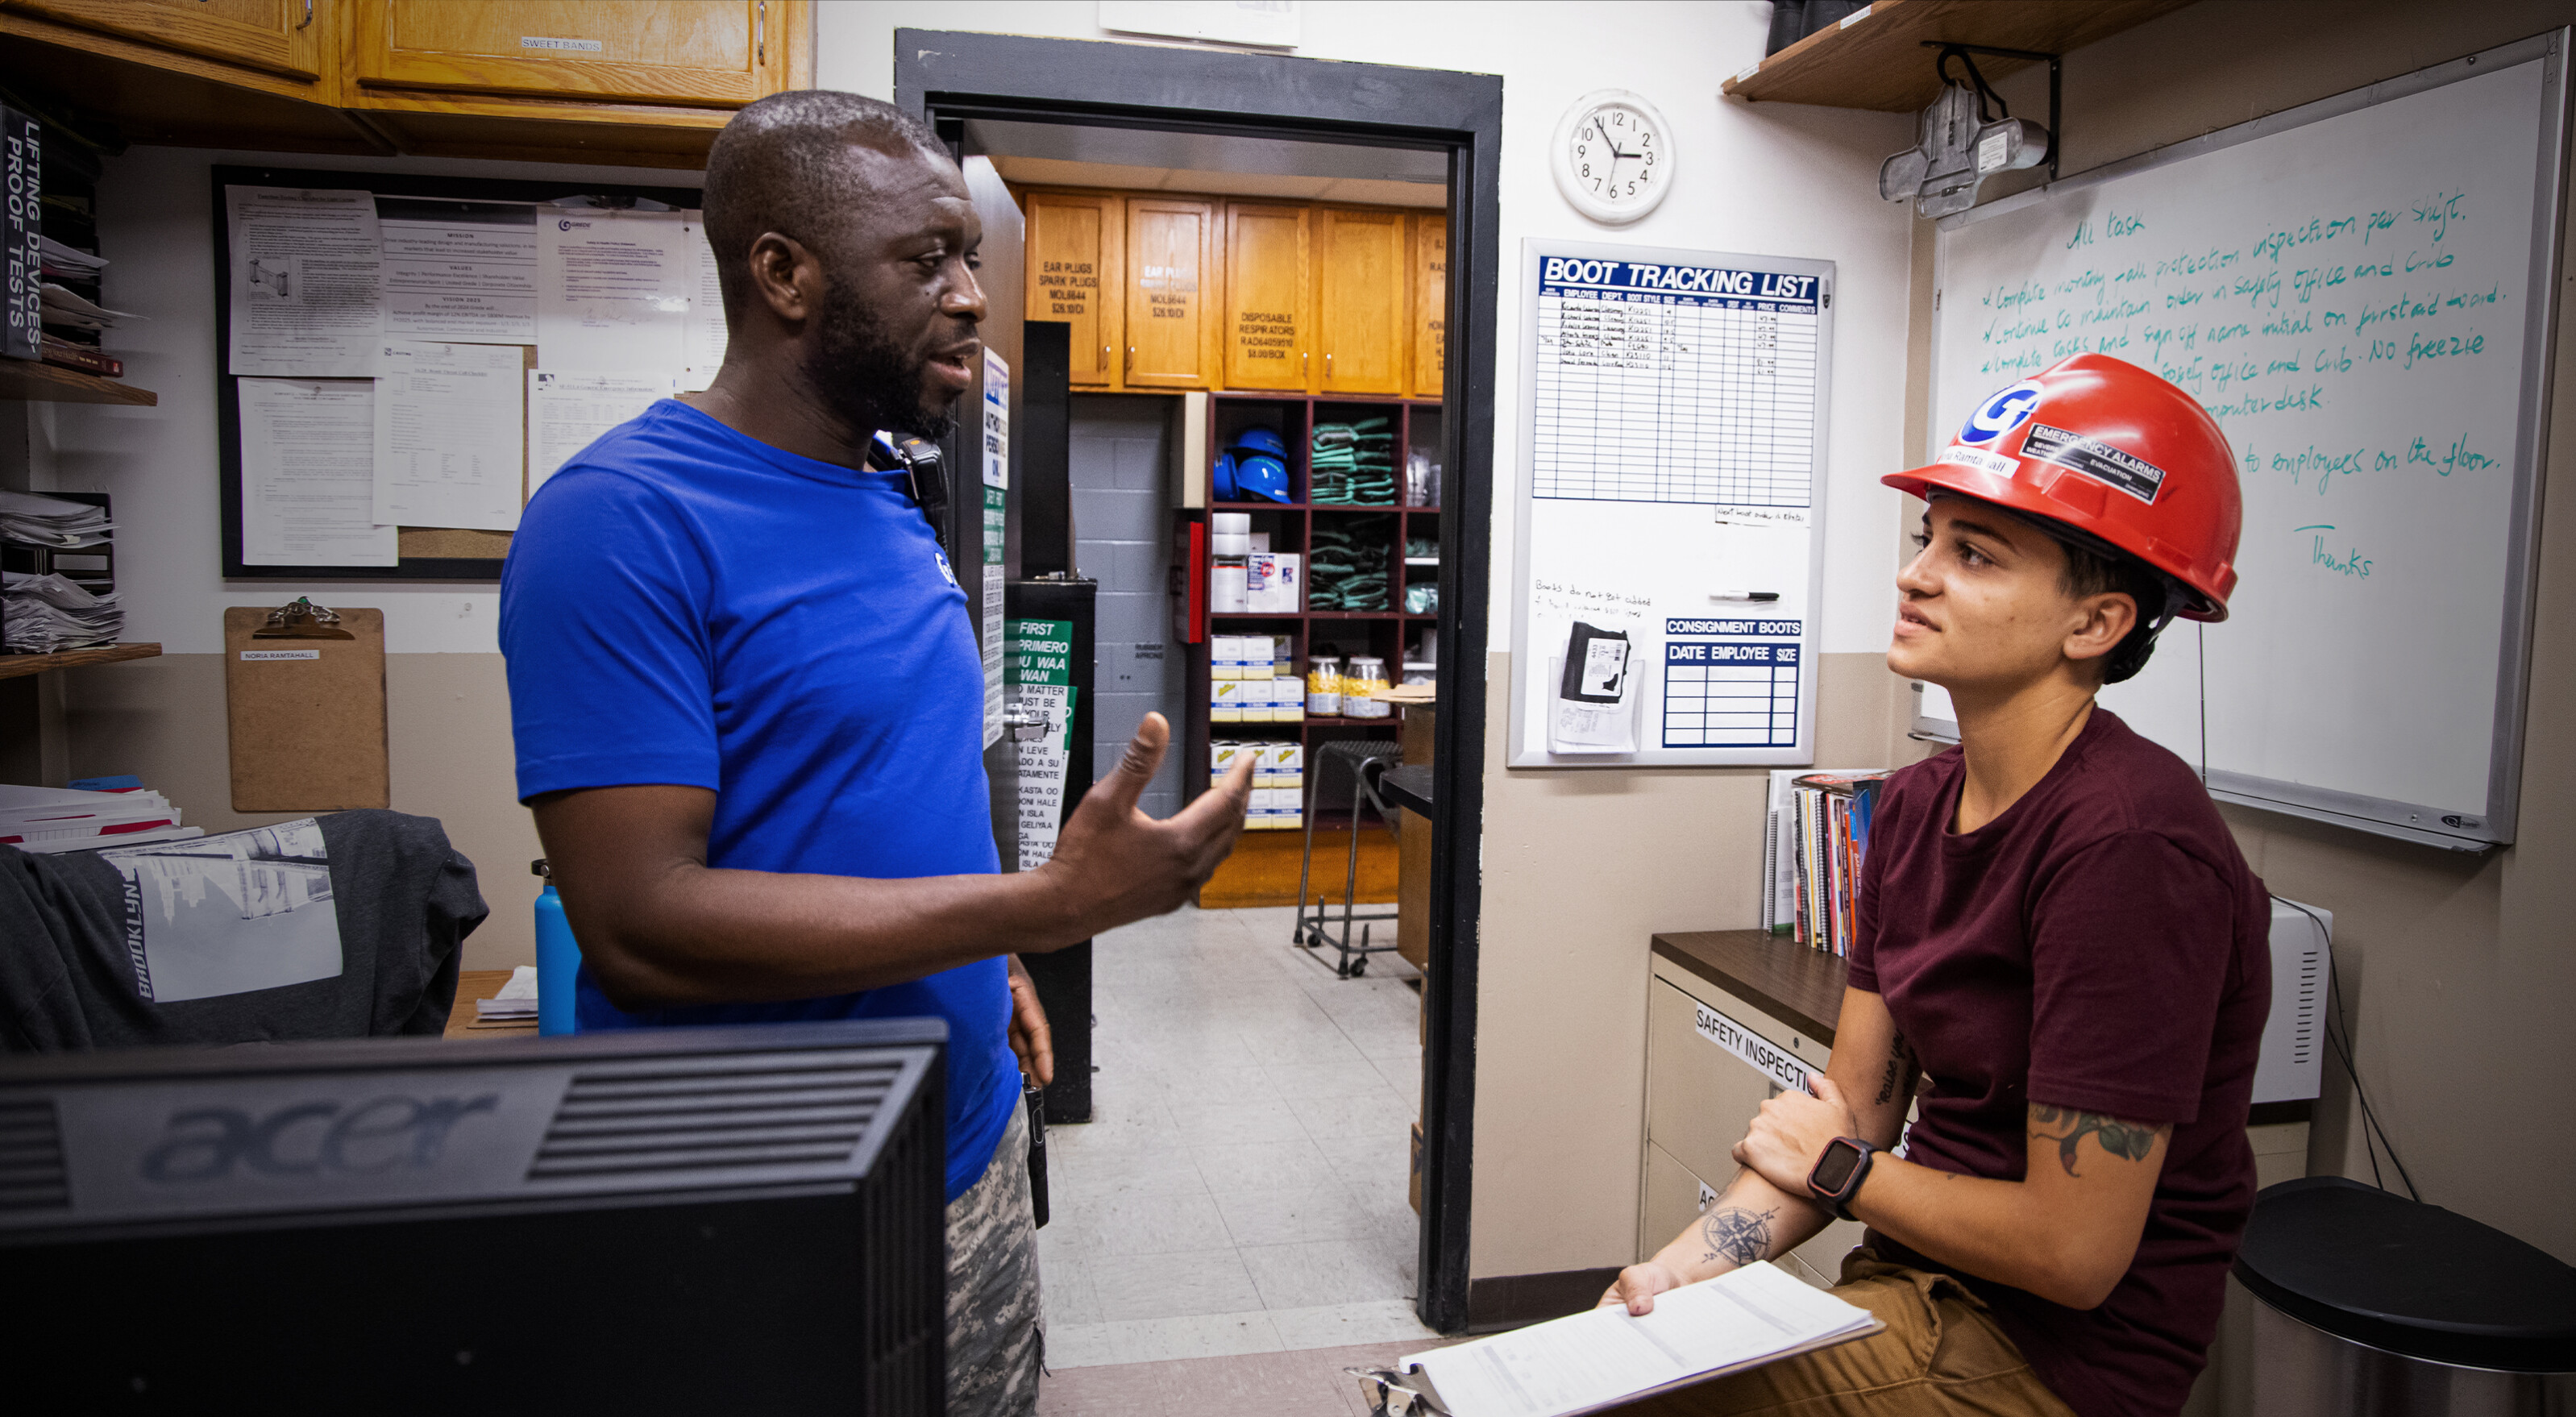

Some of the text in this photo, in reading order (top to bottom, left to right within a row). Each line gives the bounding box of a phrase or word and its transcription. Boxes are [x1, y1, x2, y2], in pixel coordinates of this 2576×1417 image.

[523, 39, 599, 51] SWEET BANDS
[1613, 112, 1623, 126] 12
[1633, 119, 1635, 131] 1
[1582, 127, 1593, 141] 10
[1643, 133, 1650, 147] 2
[1578, 145, 1585, 159] 9
[1646, 152, 1653, 165] 3
[1582, 164, 1589, 177] 8
[1640, 169, 1647, 183] 4
[1594, 178, 1602, 191] 7
[1610, 185, 1617, 198] 6
[1627, 181, 1635, 195] 5
[7, 135, 24, 328] PROOF TESTS
[2067, 210, 2145, 249] All task
[2366, 210, 2402, 245] per
[25, 121, 40, 353] LIFTING DEVICES-
[1044, 262, 1091, 274] EAR PLUGS
[1145, 265, 1162, 277] EAR
[1039, 275, 1096, 288] SPARK PLUGS
[1544, 258, 1814, 298] BOOT TRACKING LIST
[2057, 309, 2071, 329] to
[2214, 284, 2226, 300] in
[2354, 252, 2393, 277] and
[1564, 289, 1598, 299] EMPLOYEE
[1602, 292, 1623, 301] DEPT.
[1627, 293, 1642, 301] BOOT
[1643, 295, 1660, 303] STYLE
[1664, 296, 1675, 304] SIZE
[1757, 302, 1776, 311] PRICE
[1779, 304, 1815, 314] COMMENTS
[1242, 312, 1292, 323] DISPOSABLE
[2324, 310, 2346, 327] on
[1240, 324, 1294, 335] RESPIRATORS
[2267, 348, 2300, 375] and
[2034, 426, 2162, 480] EMERGENCY ALARMS
[2245, 443, 2260, 472] to
[2374, 450, 2397, 472] on
[2408, 437, 2437, 467] the
[1955, 451, 2006, 472] Ramtaall
[2090, 459, 2133, 481] EVACUATION
[2302, 528, 2373, 580] Thanks
[1570, 584, 1581, 595] do
[1020, 622, 1054, 635] FIRST
[1667, 621, 1801, 634] CONSIGNMENT BOOTS
[1669, 646, 1796, 662] DATE EMPLOYEE SIZE
[1037, 657, 1065, 670] WAA
[1027, 685, 1065, 696] MATTER
[1044, 698, 1055, 708] BE
[1027, 746, 1048, 755] LEVE
[1048, 759, 1059, 767] SU
[1037, 799, 1057, 807] HALE
[123, 883, 152, 999] BROOKLYN
[1696, 1009, 1743, 1051] SAFETY
[139, 1091, 500, 1182] acer
